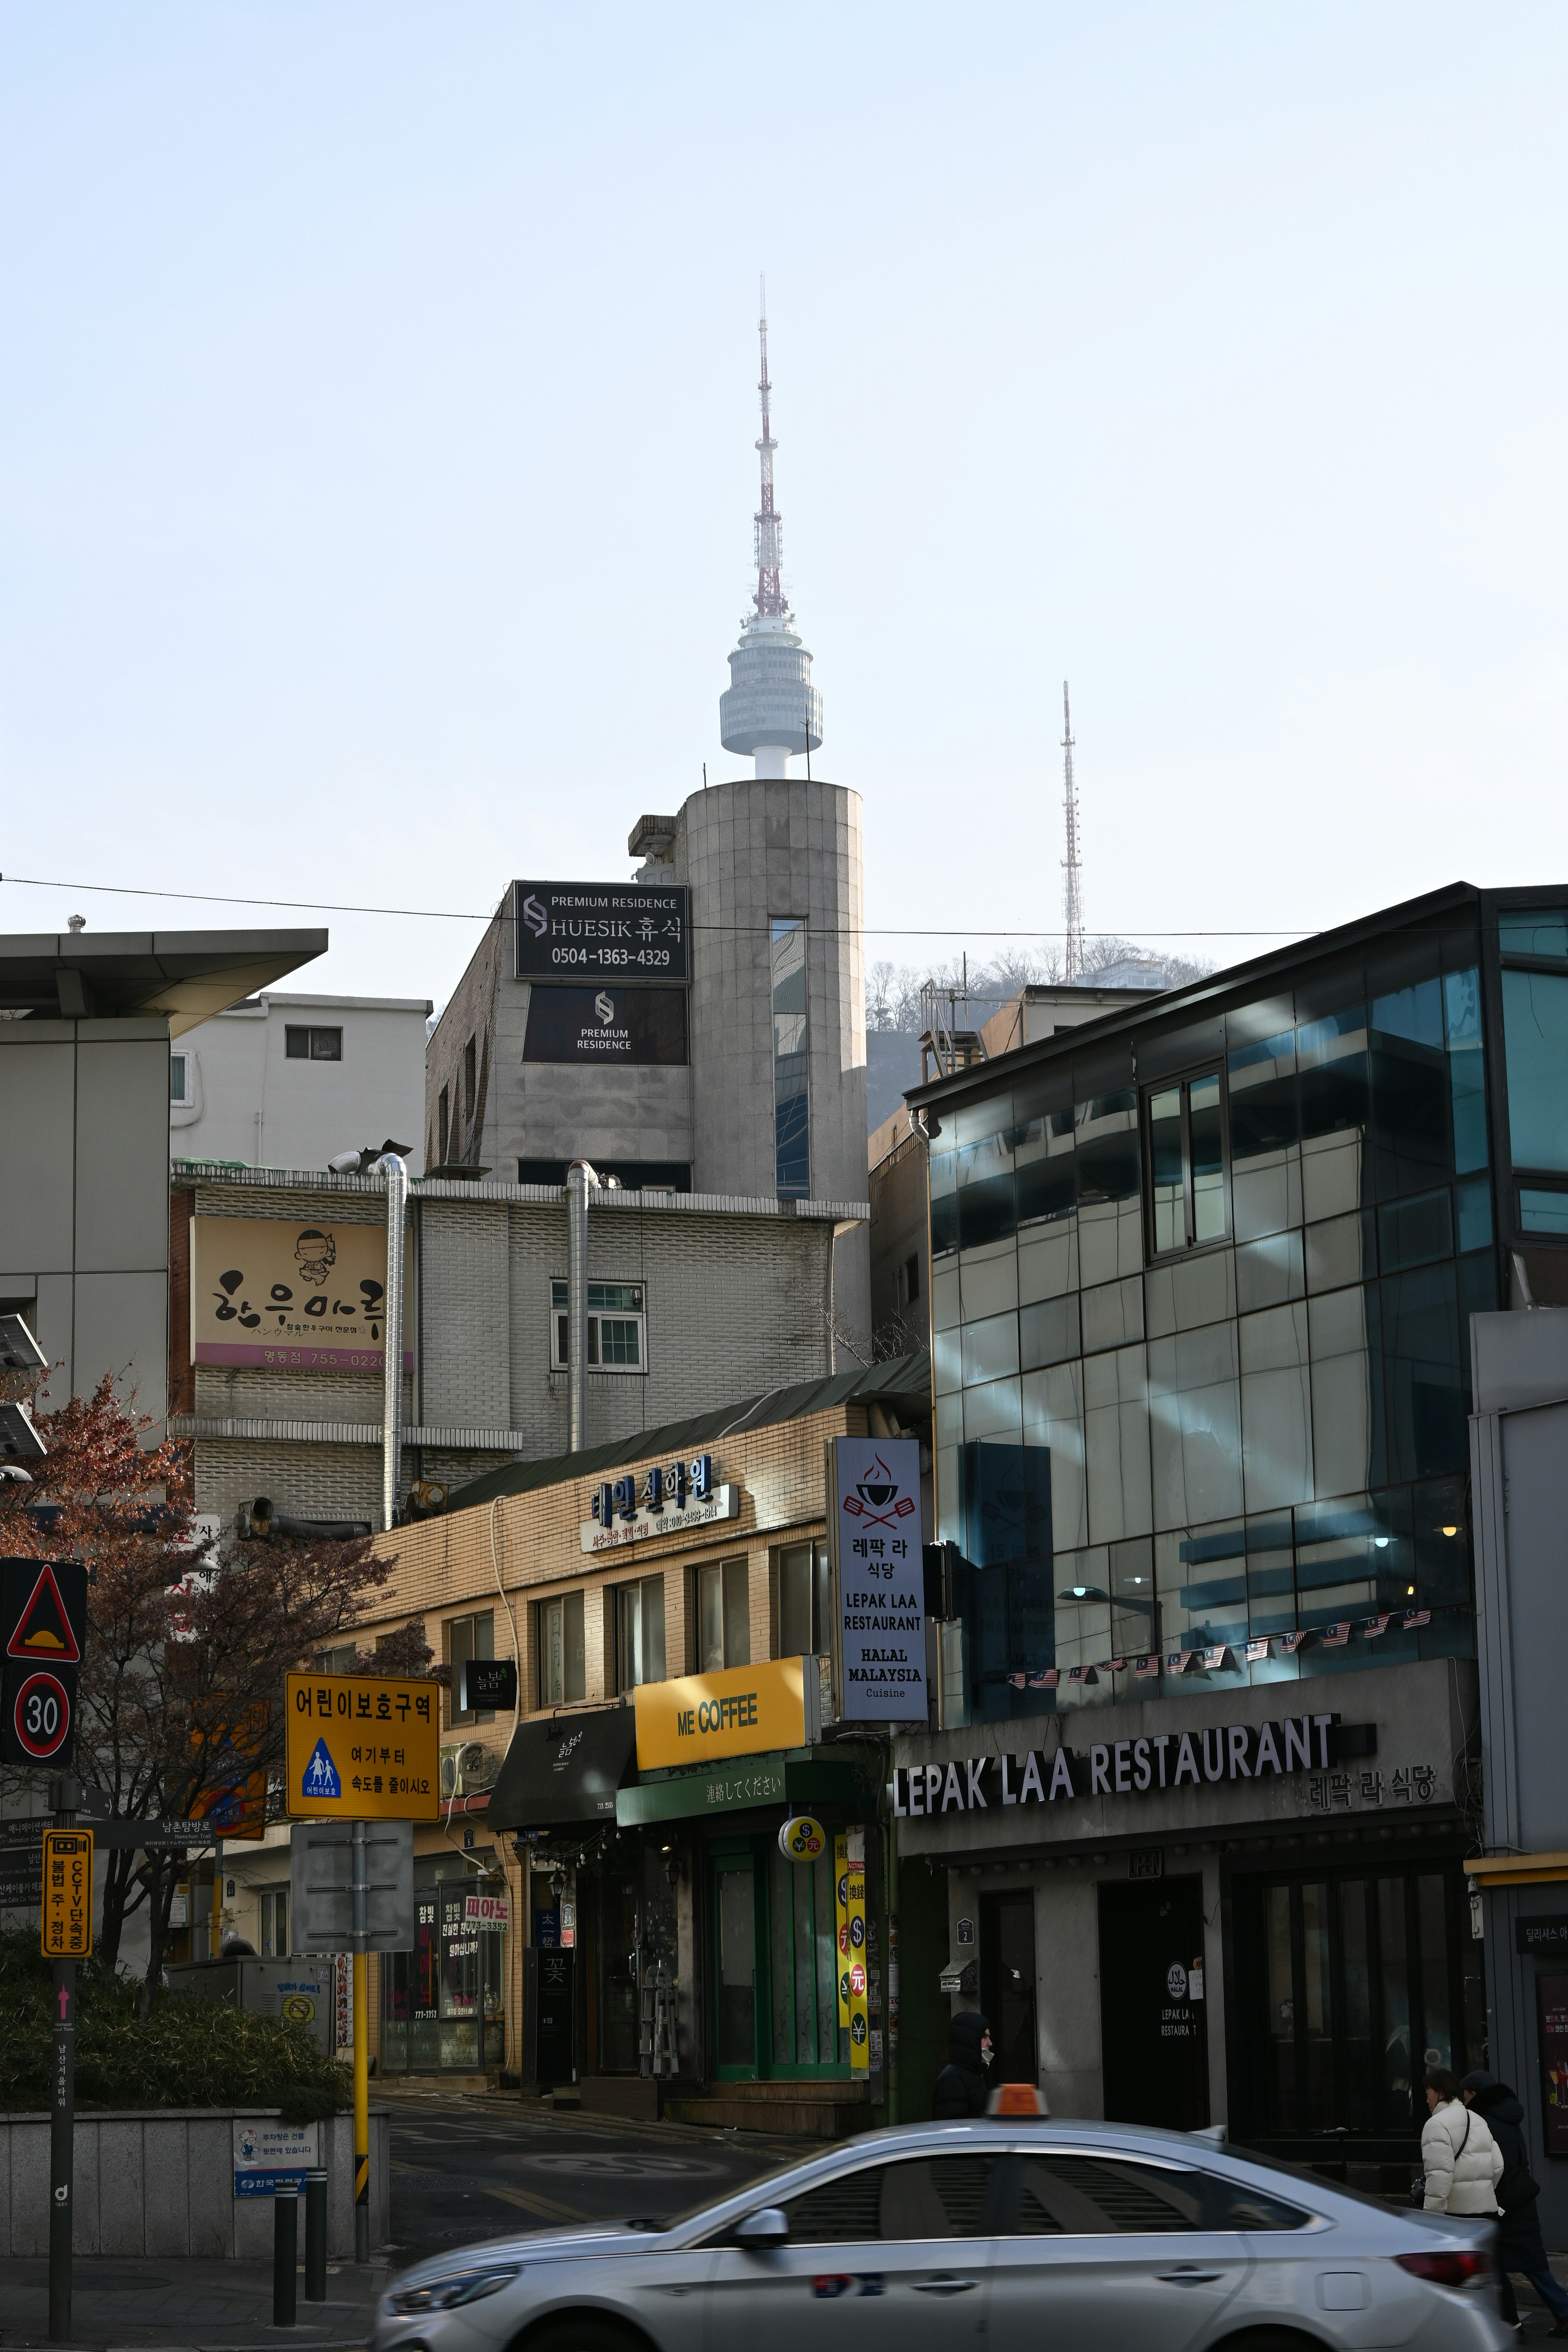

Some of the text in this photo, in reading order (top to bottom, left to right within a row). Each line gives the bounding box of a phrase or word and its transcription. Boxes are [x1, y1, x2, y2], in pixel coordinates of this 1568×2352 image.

[552, 896, 677, 909] PREMIUM RESIDENCE
[551, 917, 681, 943] HUESIK 휴식
[552, 947, 670, 966] 0504-1363-4329
[581, 1029, 629, 1038] PREMIUM
[577, 1040, 631, 1049] RESIDENCE
[212, 1270, 384, 1340] 한우마루
[251, 1328, 305, 1338] ハンウマル
[264, 1350, 301, 1364] 명동점
[853, 1539, 908, 1559] 레팍 라
[868, 1563, 894, 1580] 식당
[847, 1593, 917, 1609] LEPAK LAA
[845, 1615, 920, 1631] RESTAURANT
[862, 1649, 907, 1662] HALAL
[849, 1669, 922, 1682] MALAYSIA
[866, 1688, 905, 1698] Cuisine
[297, 1688, 430, 1724] 어린이보호구역
[27, 1696, 57, 1734] 30
[678, 1693, 758, 1737] ME COFFEE
[351, 1746, 405, 1765] 여기부터
[893, 1713, 1340, 1817] LEPAK LAA RESTAURANT
[307, 1786, 336, 1795] 어린이보호
[351, 1775, 430, 1794] 속도를 줄이시오
[707, 1776, 781, 1803] 連絡してください
[1309, 1764, 1434, 1810] 레팍 라 식당
[8, 1820, 53, 1834] 애니메이션센터
[163, 1821, 211, 1833] 남촌탐방로
[808, 1840, 819, 1850] 元
[28, 1852, 43, 1864] 남산
[1130, 1852, 1160, 1876] PEN
[51, 1860, 65, 1887] 불법
[849, 1884, 865, 1901] 換錢
[70, 1860, 83, 1950] CCTV단속중
[446, 1903, 460, 1922] 참빛
[467, 1898, 508, 1919] 피아노
[51, 1894, 65, 1949] 주·정차
[419, 1906, 434, 1923] 참빛
[442, 1923, 458, 1936] 진실한
[466, 1920, 507, 1930] 773-3352
[964, 1932, 967, 1941] 2
[1526, 1927, 1557, 1942] 딜리셔스
[449, 1941, 478, 1957] 원하십니까?
[544, 1958, 566, 1983] 꽃
[1168, 1970, 1185, 1985] حلال
[278, 1983, 321, 1993] 담배가 싫어요!
[852, 1971, 865, 1991] 元
[415, 2010, 437, 2020] 773-3352
[1162, 2009, 1180, 2020] LEPAK
[1162, 2025, 1196, 2036] RESTAURAT
[57, 2044, 67, 2107] 남산서울타워
[539, 2157, 712, 2174] 30
